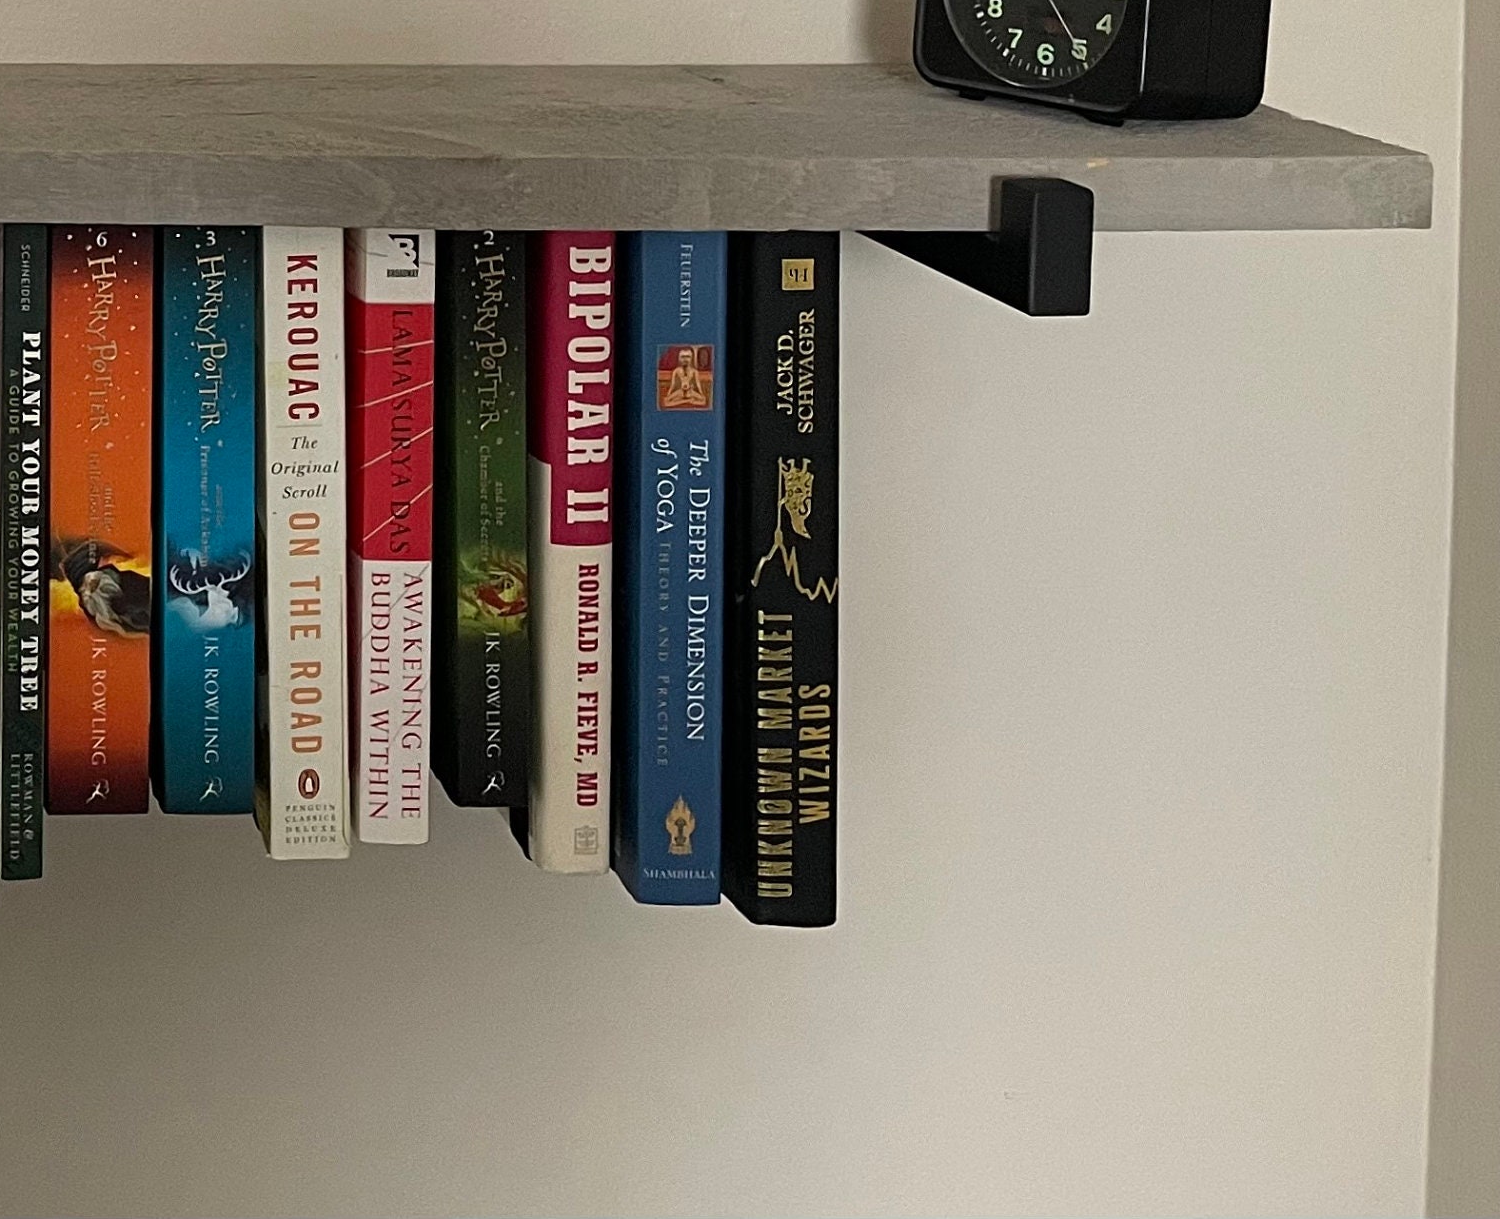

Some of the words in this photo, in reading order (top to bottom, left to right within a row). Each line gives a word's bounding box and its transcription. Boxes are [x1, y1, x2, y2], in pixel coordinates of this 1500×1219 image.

[1008, 29, 1023, 49] 7
[1037, 44, 1055, 65] 6
[1072, 39, 1087, 60] 5
[1096, 14, 1112, 34] 4
[96, 232, 108, 247] 6
[206, 231, 216, 246] 3
[483, 230, 494, 245] 2
[20, 244, 31, 312] SCHNEIDER
[86, 256, 118, 340] HARRY
[196, 255, 226, 338] HARRY
[473, 254, 505, 338] HARRY
[680, 244, 694, 327] FEUERSTEIN
[9, 369, 18, 377] A
[287, 255, 319, 420] KEROUAC
[391, 310, 413, 386] LAMA
[567, 246, 612, 465] BIPOLAR
[777, 330, 793, 350] D.
[798, 309, 814, 434] SCHWAGER
[8, 386, 19, 434] GUIDE
[22, 331, 41, 426] PLANT
[88, 340, 118, 434] POTTER
[198, 338, 227, 432] POTTER
[475, 338, 507, 431] POTTER
[776, 357, 794, 415] JACK
[8, 444, 19, 462] TO
[21, 439, 40, 514] YOUR
[272, 460, 338, 477] Original
[292, 436, 318, 449] The
[390, 398, 413, 487] SURYA
[651, 438, 677, 458] of
[689, 440, 709, 476] The
[8, 471, 20, 549] GROWING
[282, 484, 327, 499] Scroll
[389, 500, 411, 554] DAS
[496, 482, 506, 503] and
[496, 507, 506, 525] the
[566, 489, 609, 524] II
[656, 463, 678, 532] YOGA
[288, 512, 320, 556] ON
[688, 488, 710, 581] DEEPER
[7, 558, 19, 600] YOUR
[20, 526, 40, 622] MONEY
[289, 576, 321, 640] THE
[578, 564, 599, 652] RONALD
[658, 541, 671, 612] THEORY
[7, 609, 19, 672] WEALTH
[370, 573, 390, 695] BUDDHA
[401, 573, 422, 749] AWAKENING
[657, 624, 669, 661] AND
[686, 595, 709, 740] DIMENSION
[757, 610, 793, 729] MARKET
[20, 636, 39, 711] TREE
[290, 662, 322, 753] ROAD
[577, 662, 598, 682] R.
[91, 670, 107, 766] ROWLING
[203, 669, 219, 764] ROWLING
[486, 664, 501, 758] ROWLING
[574, 692, 598, 763] FIEVE,
[657, 675, 670, 766] PRACTICE
[23, 753, 34, 823] ROWMAN
[369, 710, 389, 819] WITHIN
[577, 772, 597, 807] MD
[798, 685, 830, 824] WIZARDS
[10, 754, 21, 860] LITTLEFIELD
[285, 814, 335, 822] CLASSICS
[401, 763, 422, 819] THE
[757, 747, 793, 898] UNKNOWN
